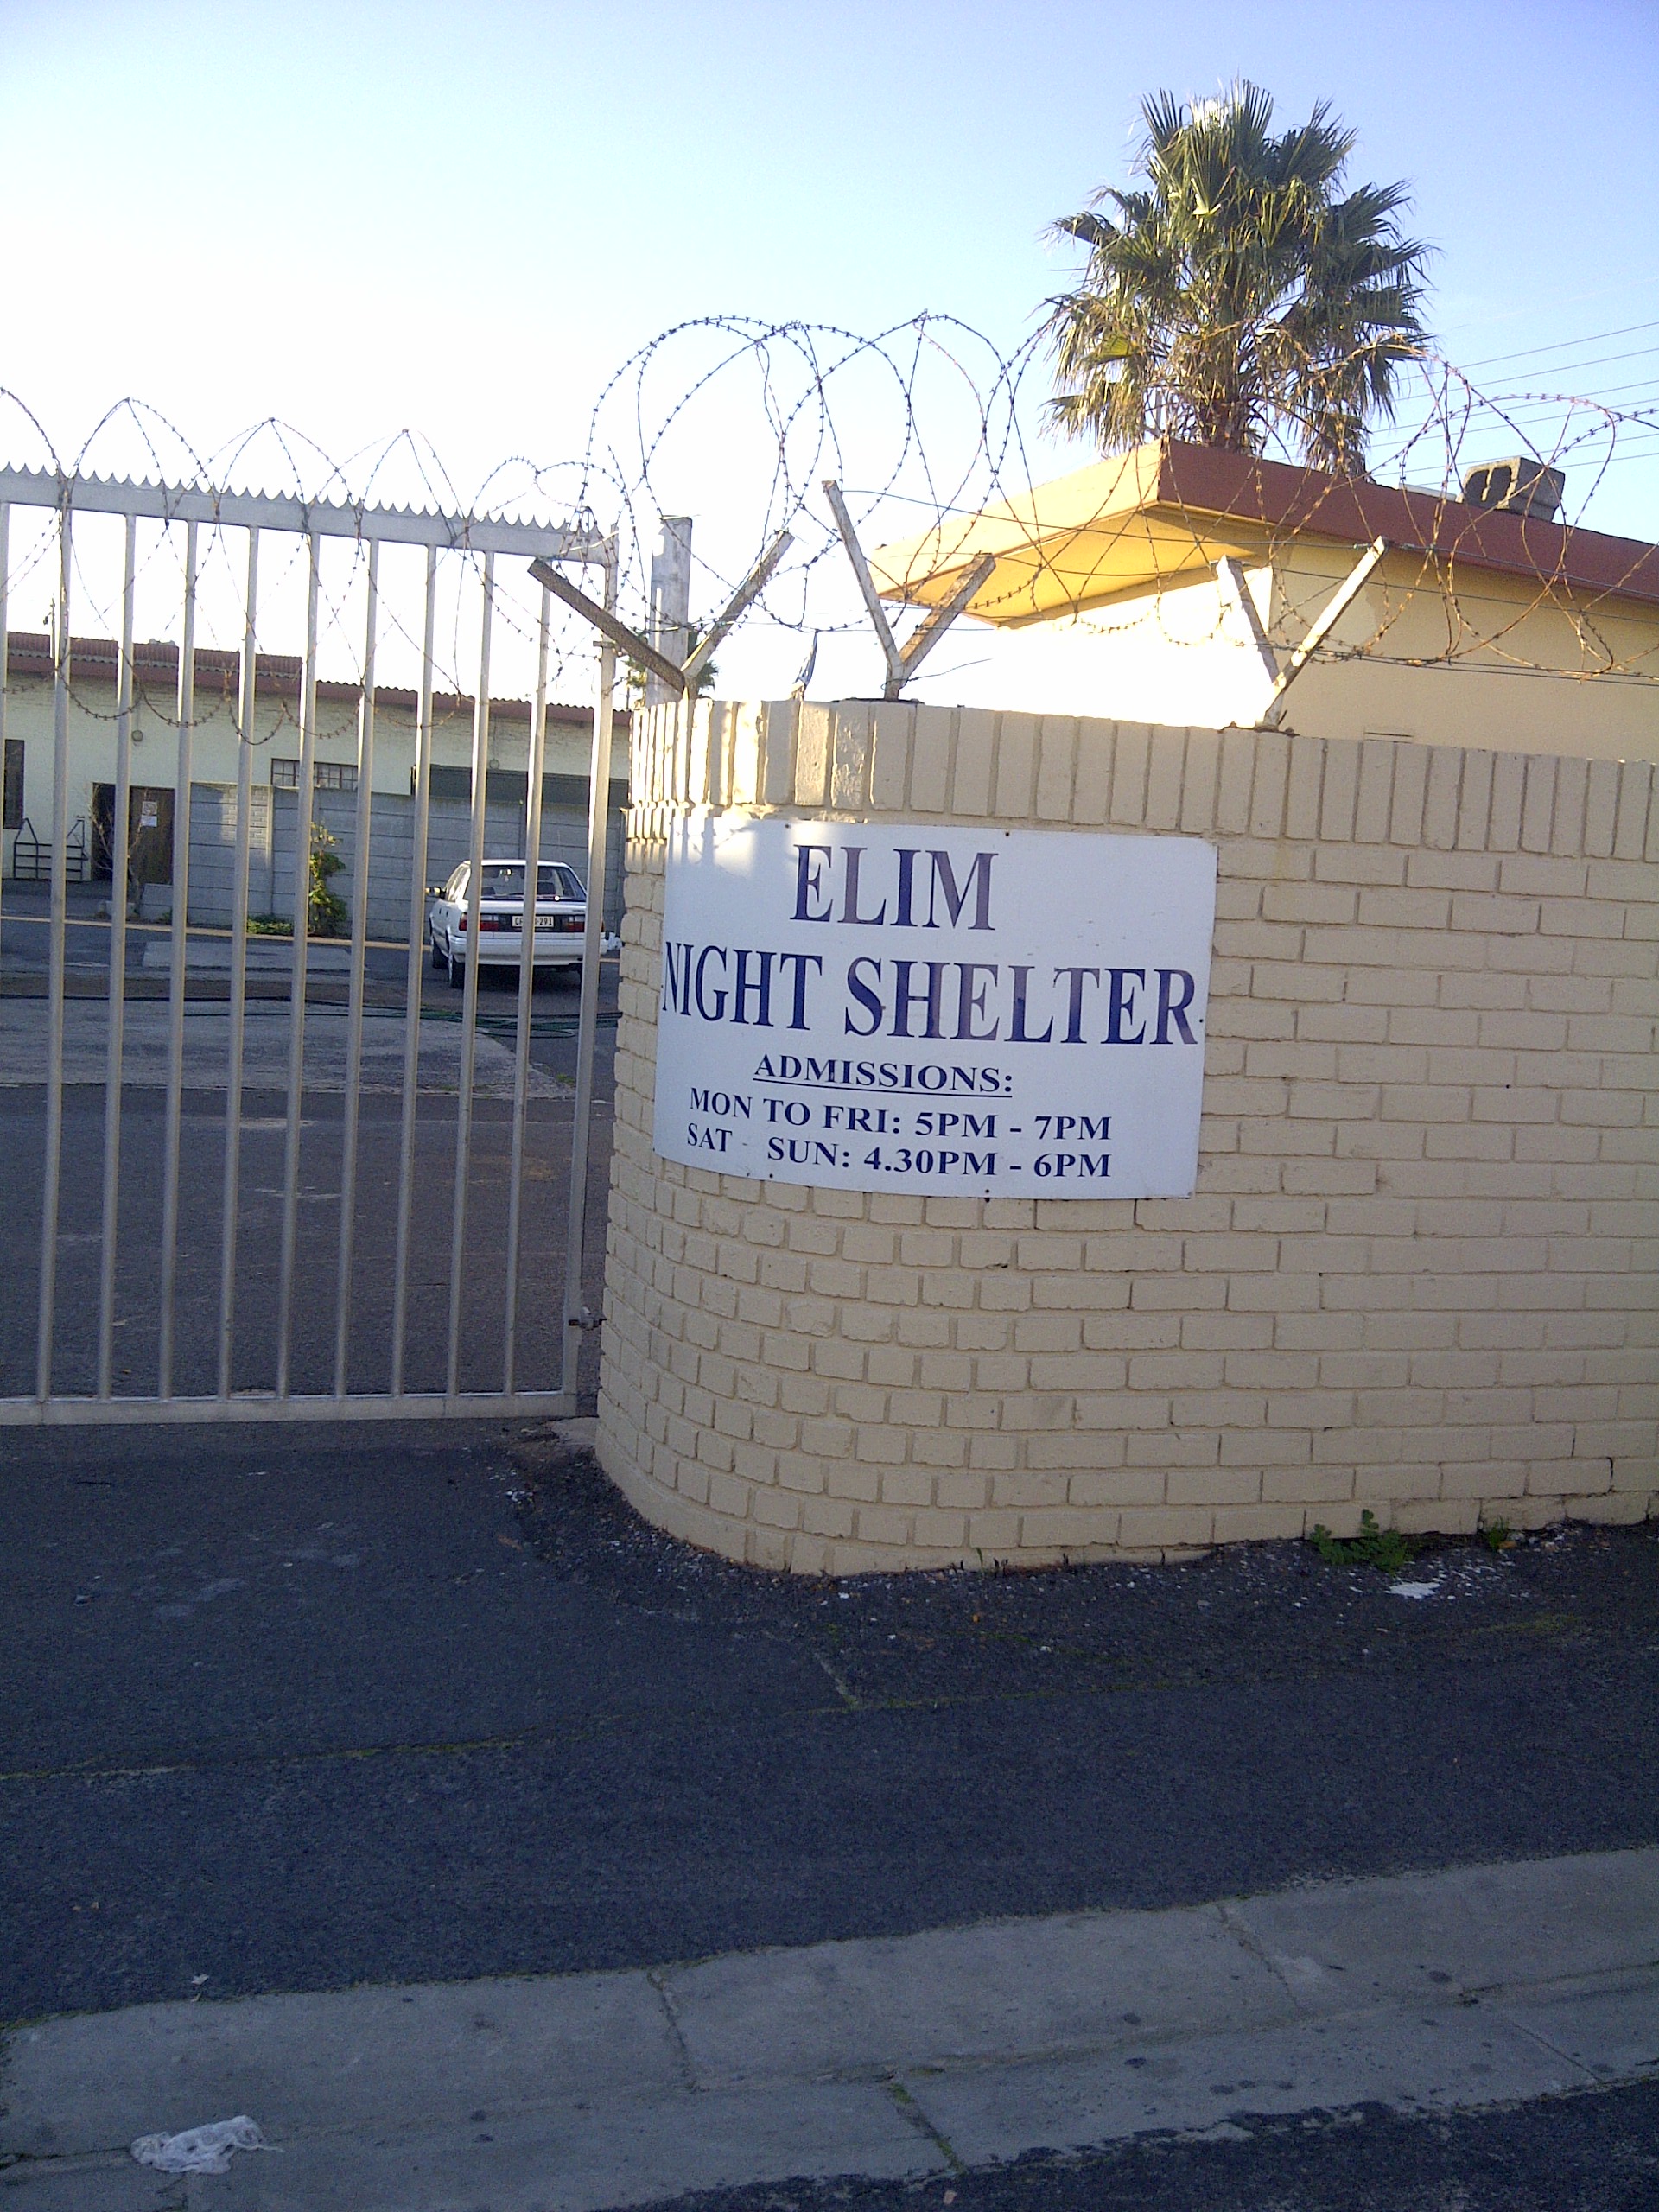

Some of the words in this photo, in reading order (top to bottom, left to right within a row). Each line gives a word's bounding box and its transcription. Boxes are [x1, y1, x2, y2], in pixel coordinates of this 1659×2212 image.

[790, 844, 999, 931] ELIM
[662, 941, 823, 1030] NIGHT
[844, 957, 1198, 1045] SHELTER
[753, 1053, 1013, 1093] ADMISSIONS:
[689, 1087, 753, 1120] MON
[763, 1098, 810, 1127] TO
[823, 1105, 900, 1135] FRI:
[915, 1112, 998, 1139] 5PM
[1034, 1115, 1111, 1141] 7PM
[687, 1123, 733, 1153] SAT
[767, 1137, 850, 1168] SUN:
[864, 1147, 998, 1176] 4.30PM
[1034, 1154, 1111, 1178] 6PM
